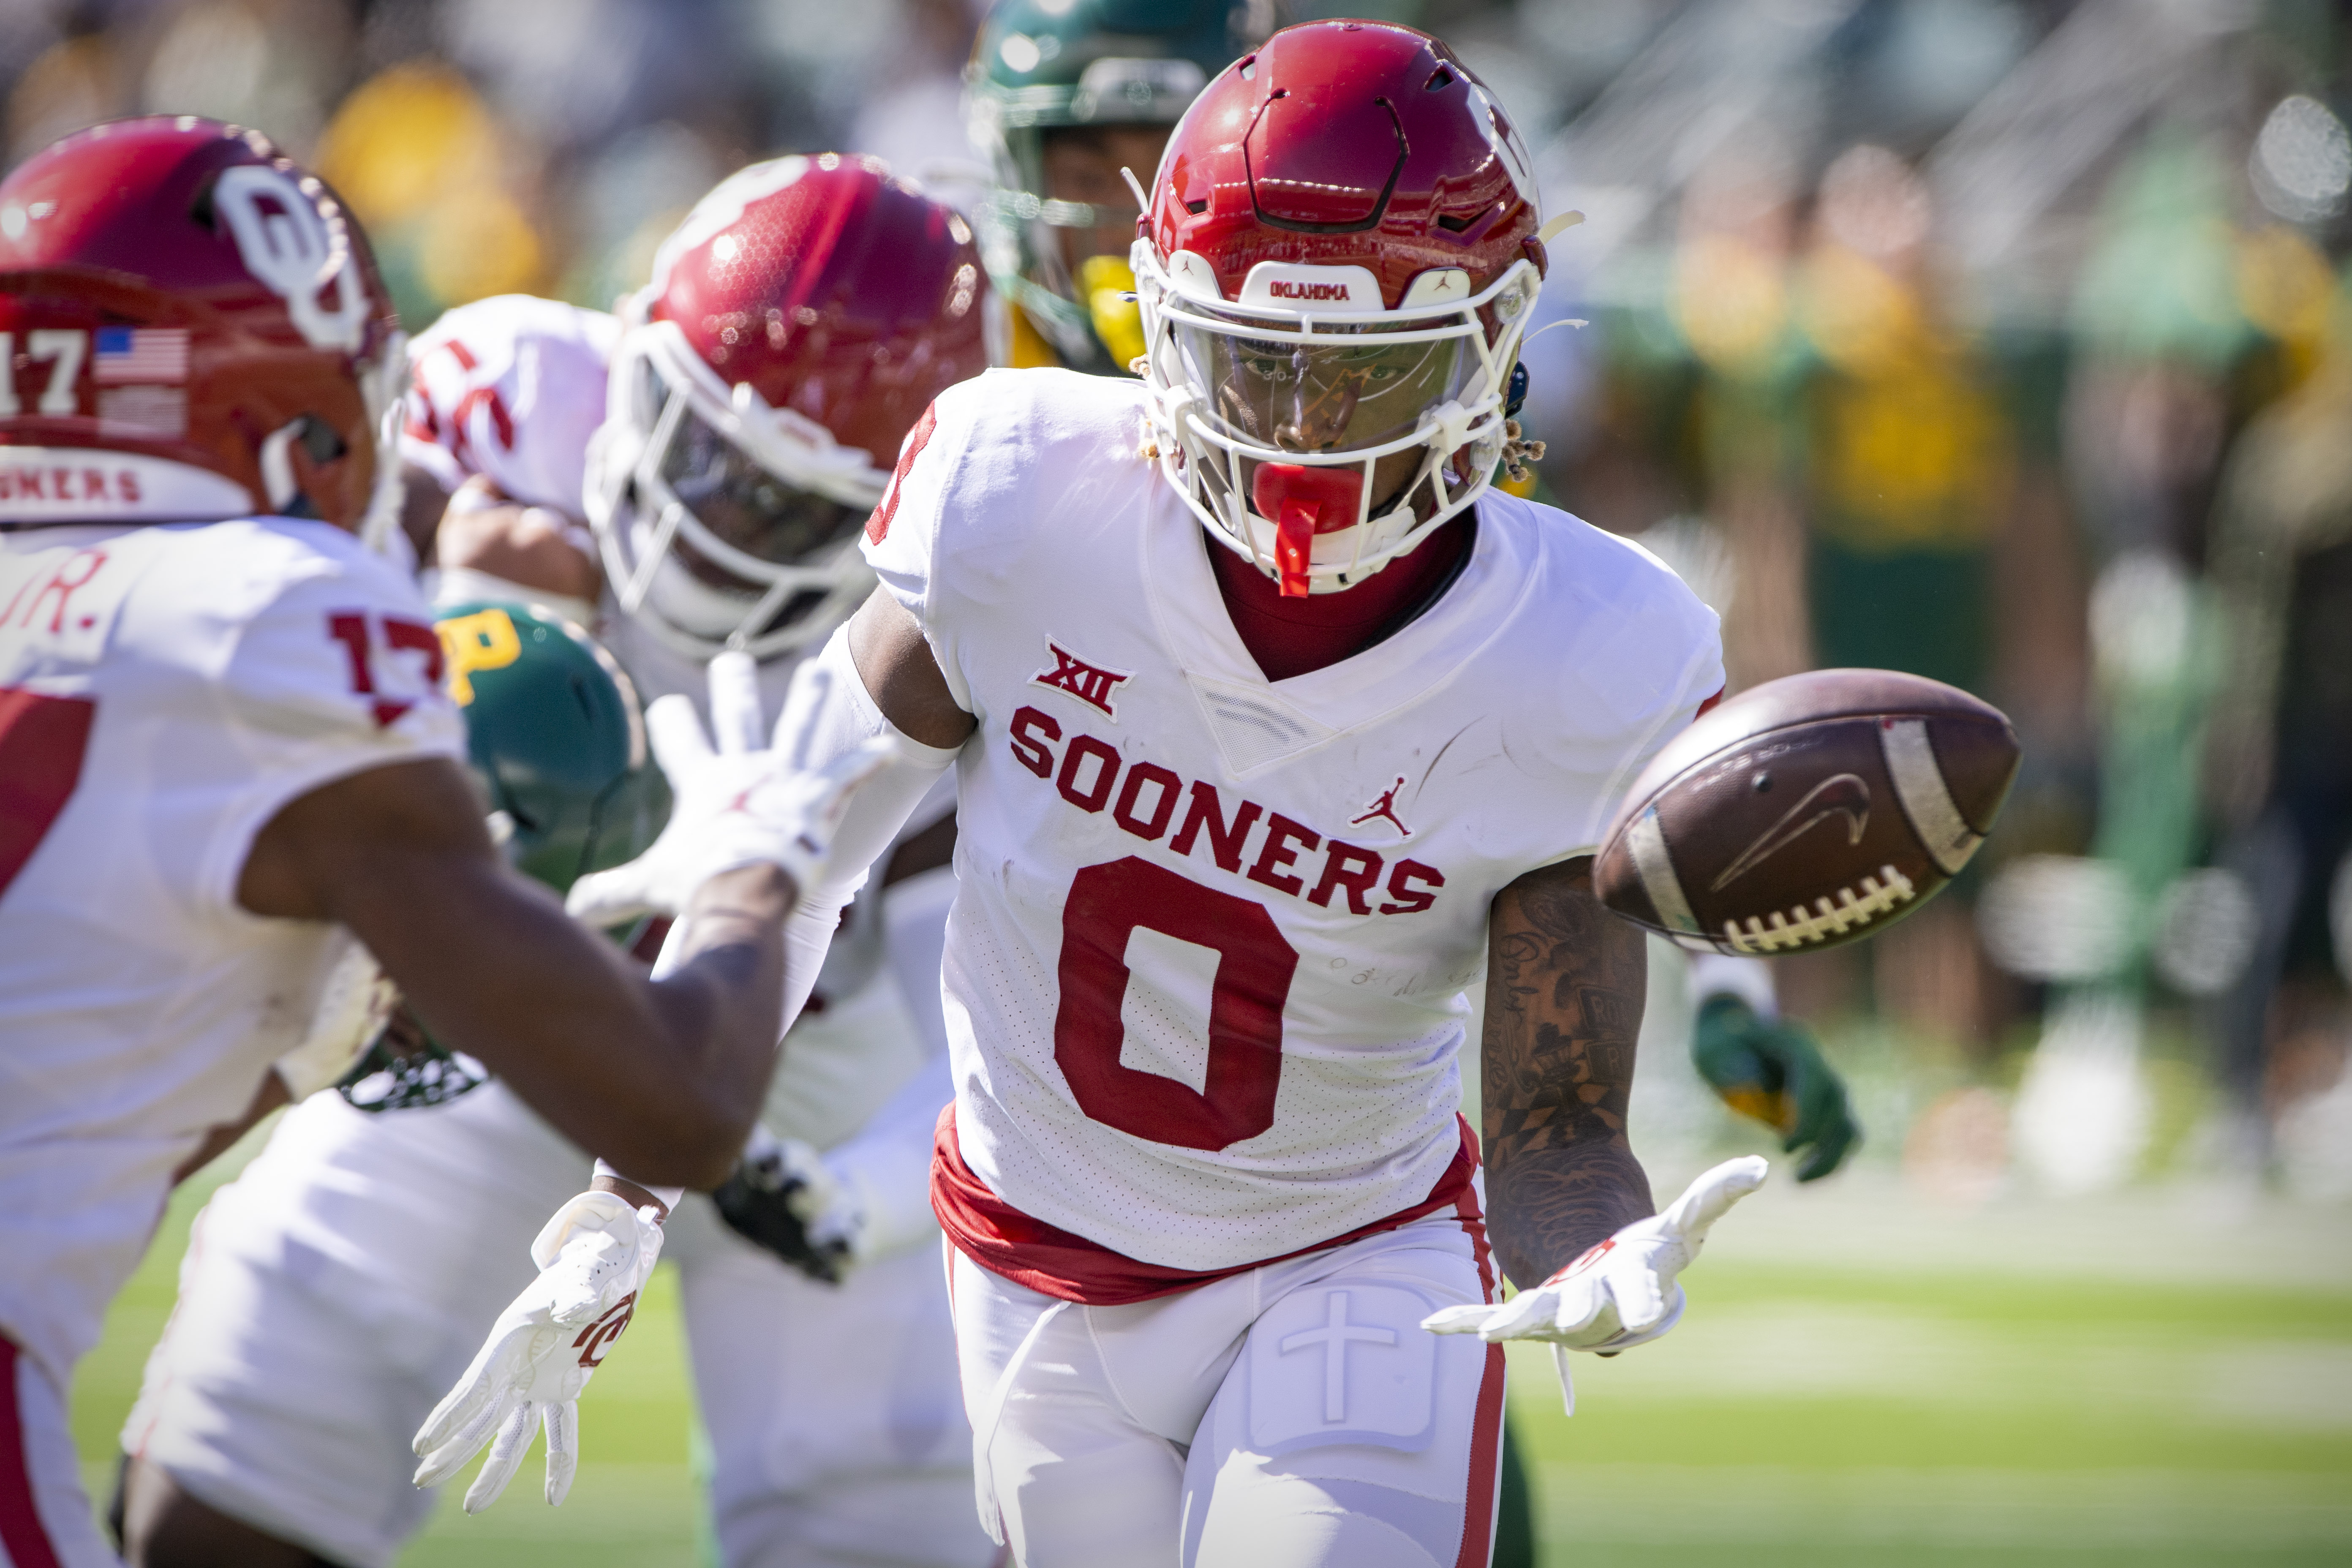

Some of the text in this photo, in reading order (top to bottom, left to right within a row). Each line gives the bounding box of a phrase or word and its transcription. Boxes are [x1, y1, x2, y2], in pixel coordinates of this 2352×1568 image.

[1269, 279, 1351, 301] OKLAHOMA
[1010, 705, 1446, 915] SOONERS
[1054, 854, 1300, 1152] 0
